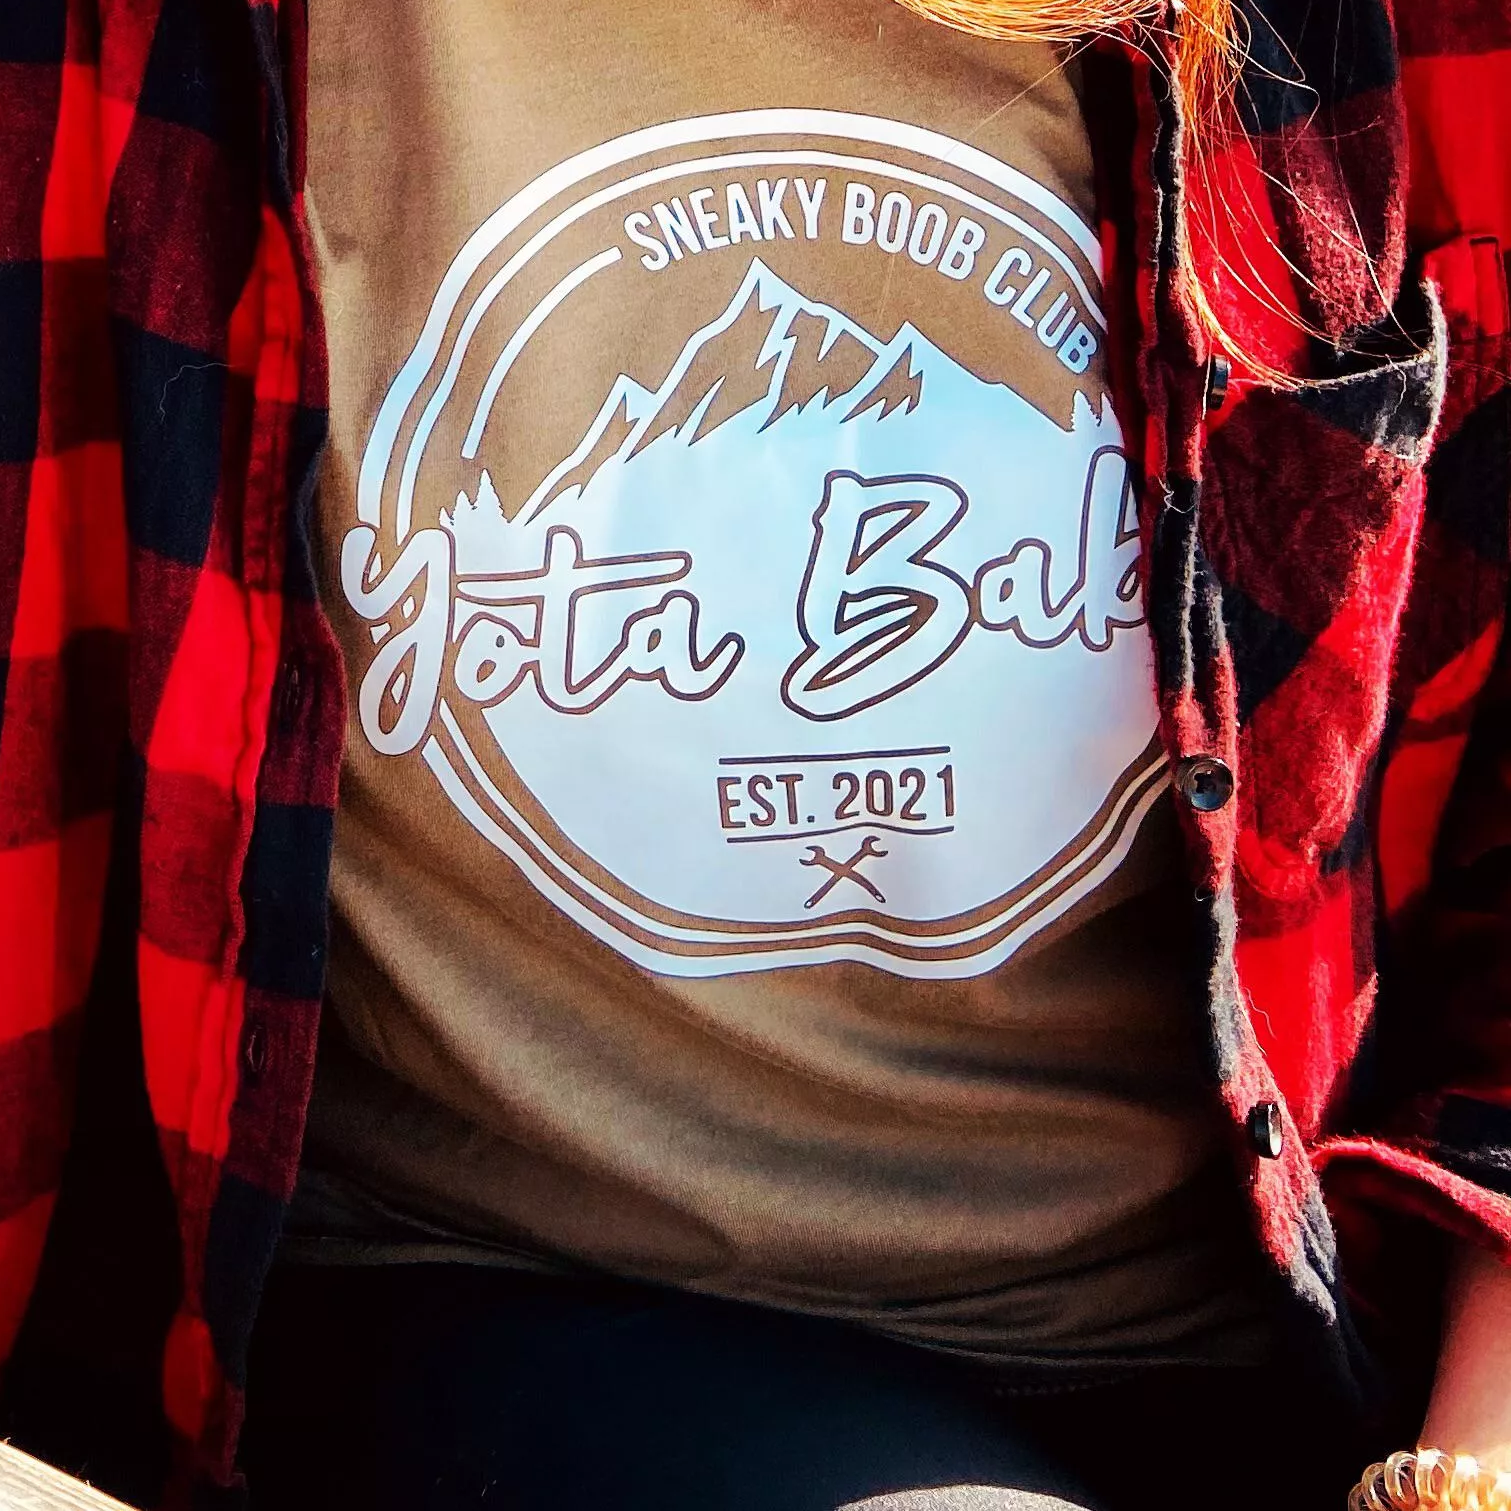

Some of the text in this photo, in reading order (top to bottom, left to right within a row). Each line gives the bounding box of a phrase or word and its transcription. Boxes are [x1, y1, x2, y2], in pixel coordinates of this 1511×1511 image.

[623, 176, 1099, 375] SNEAKY BOOB CLUB
[779, 444, 1150, 723] Bab
[716, 763, 956, 829] EST. 2021
